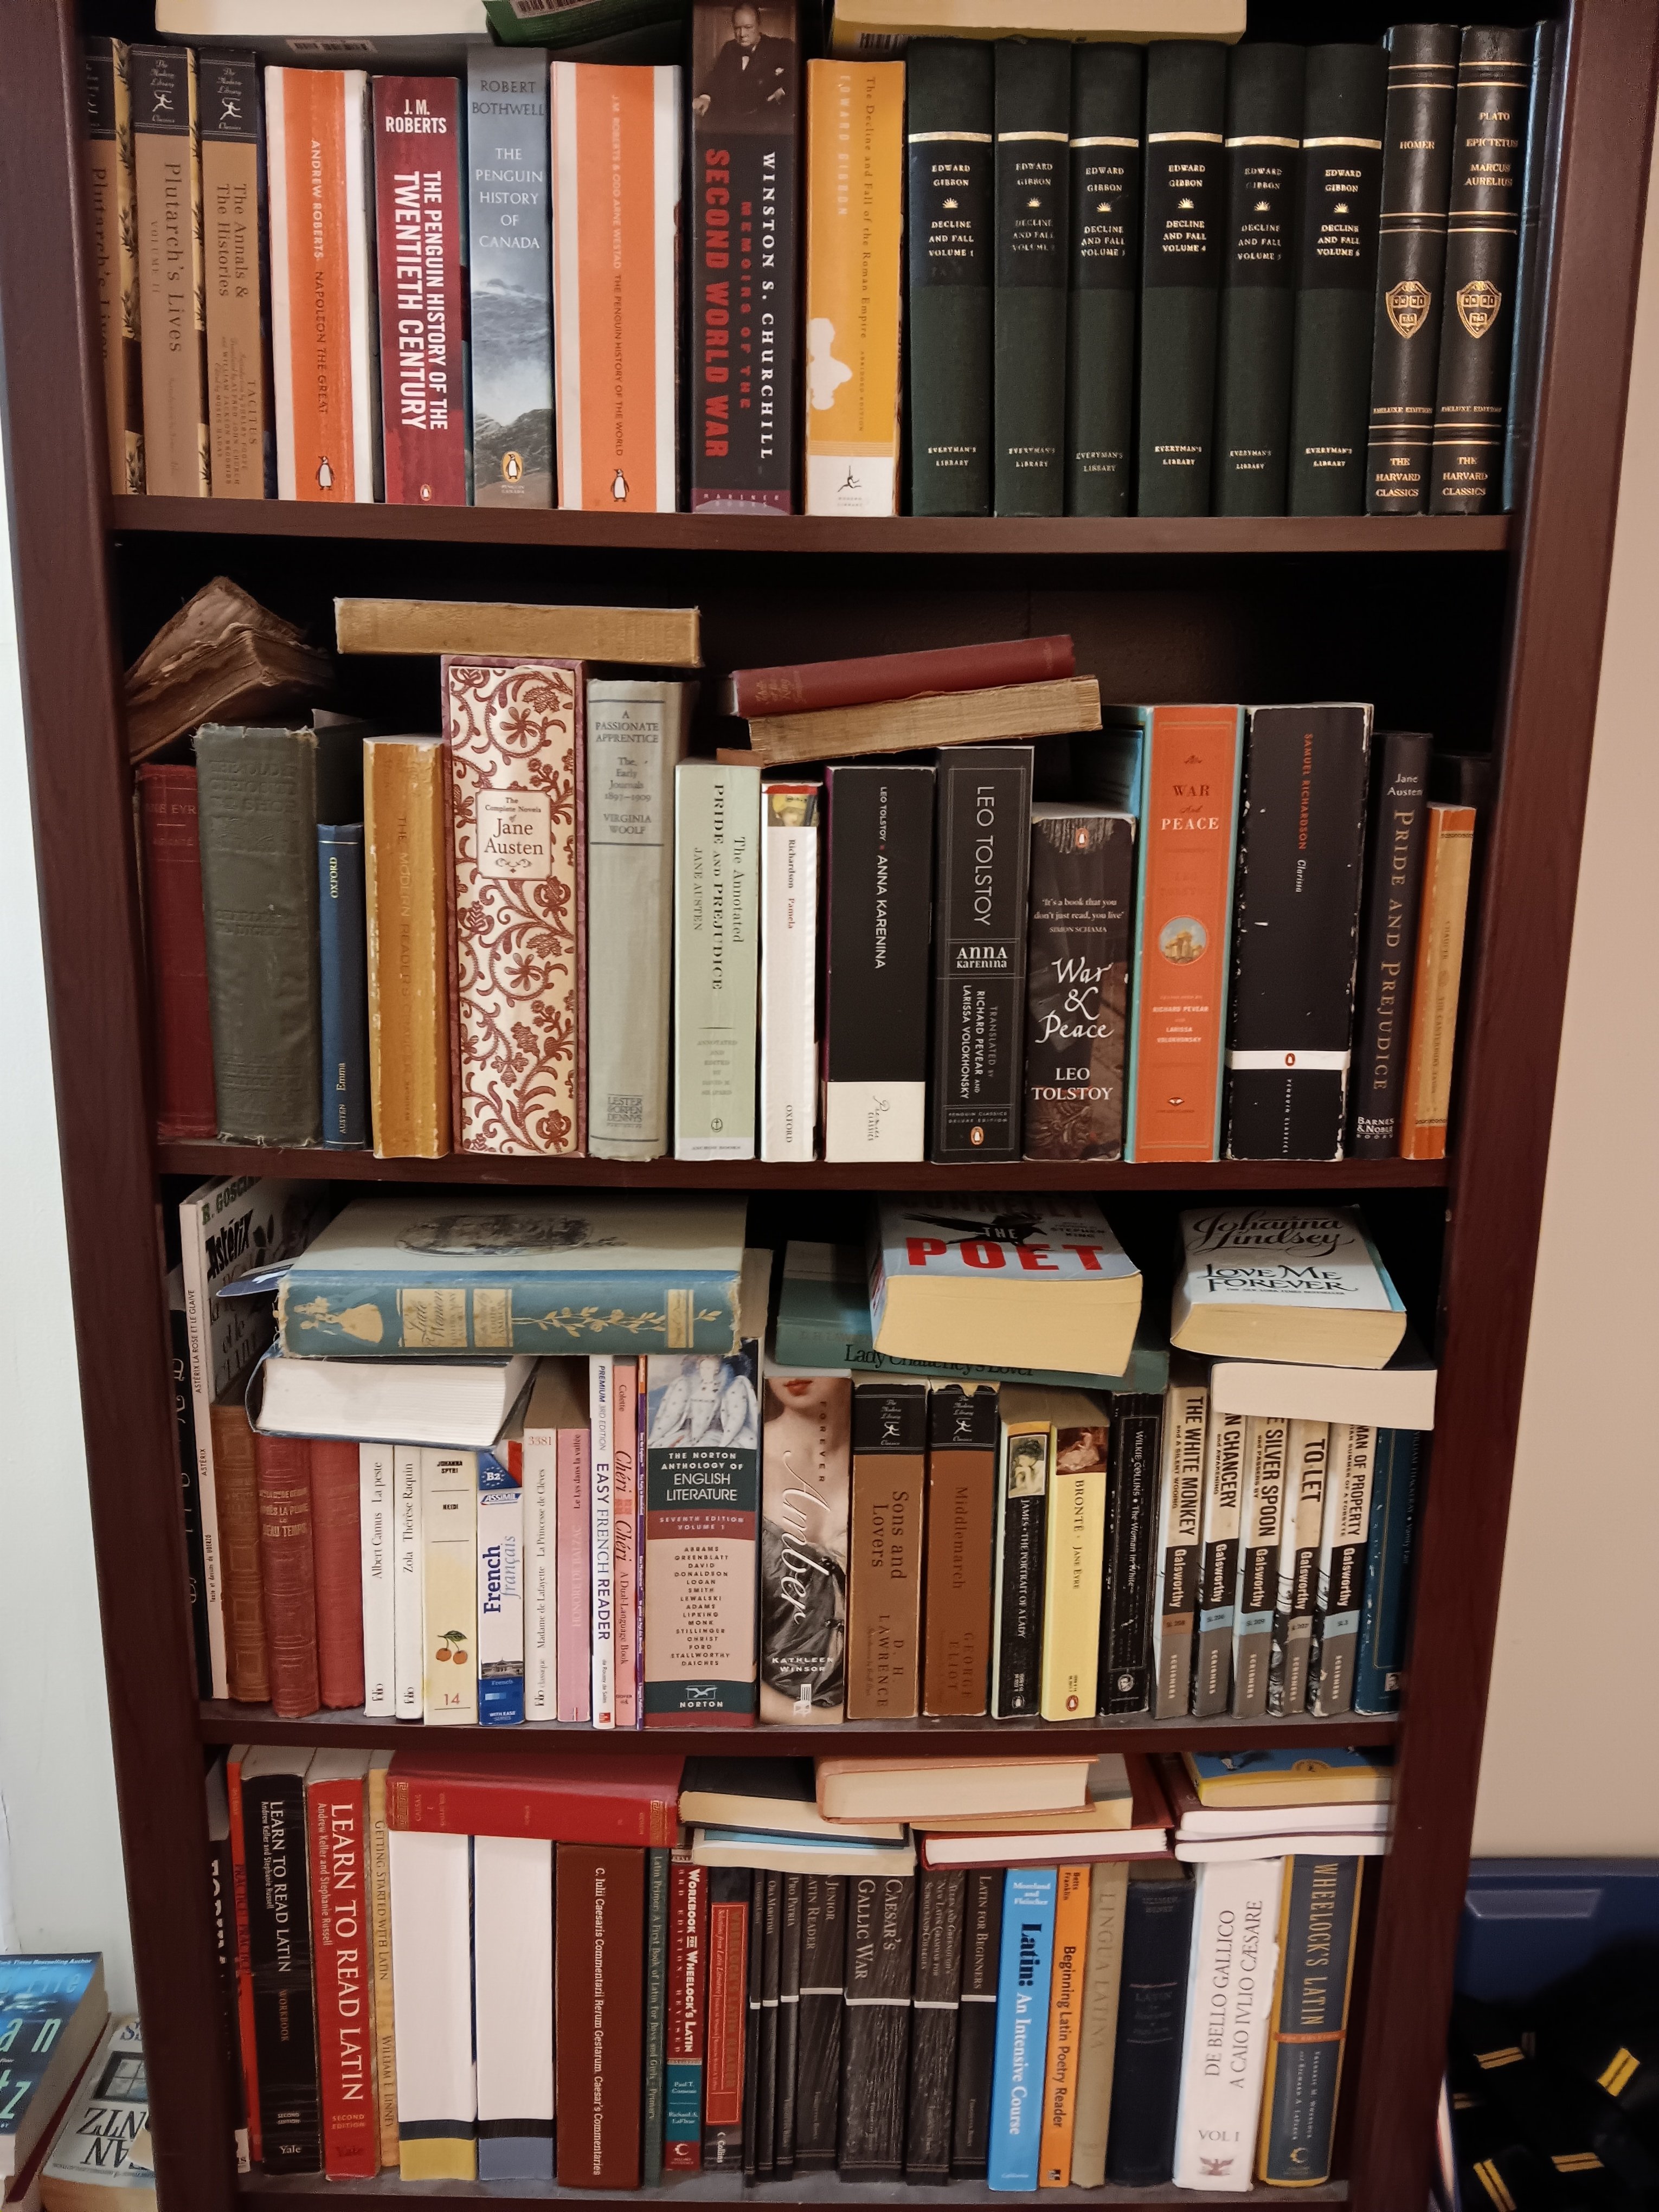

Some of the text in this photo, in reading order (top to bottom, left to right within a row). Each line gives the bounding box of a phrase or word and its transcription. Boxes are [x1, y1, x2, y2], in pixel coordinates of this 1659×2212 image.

[403, 99, 430, 116] J. M.
[471, 102, 545, 117] BOTHWELL
[480, 81, 536, 94] ROBERT
[385, 116, 447, 134] ROBERTS
[1479, 112, 1510, 121] PLATO
[494, 147, 523, 160] THE
[1399, 141, 1435, 150] HOMER
[475, 169, 543, 183] PENGUIN
[479, 192, 540, 205] HISTORY
[164, 163, 183, 281] Plutarch's
[217, 184, 232, 297] The Histories
[234, 183, 249, 298] The Annals &
[479, 236, 541, 249] CANADA
[499, 214, 520, 227] OF
[168, 293, 185, 353] Lives
[394, 170, 427, 430] TWENTIETH CENTURY
[423, 170, 448, 430] THE PENGUIN HISTORY OF THE
[705, 149, 730, 458] SECOND WORLD WAR
[760, 151, 776, 459] WINSTON S. CHURCHILL
[1375, 473, 1420, 482] HARVARD
[1375, 488, 1419, 497] CLASSICS
[595, 722, 660, 732] PASSIONATE
[595, 733, 660, 743] APPRENTICE
[1172, 785, 1211, 797] WAR
[1298, 732, 1313, 850] SAMUEL RICHARDSON
[1394, 774, 1419, 784] Jane
[485, 805, 515, 813] Complete
[493, 816, 534, 838] Jane
[603, 813, 652, 824] VIRGINIA
[1161, 817, 1220, 830] PEACE
[483, 840, 544, 856] Austen
[973, 786, 995, 926] LEO TOLSTOY
[693, 847, 703, 931] JANE AUSTEN
[711, 784, 725, 991] PRIDE AND PREJUDICE
[732, 836, 746, 943] The Annotated
[874, 786, 889, 969] LEO TOLSTOY ANNA KARENINA
[1295, 859, 1308, 893] Clarissa
[1051, 956, 1114, 984] War
[1373, 810, 1415, 1090] PRIDE AND PREJUDICE
[1064, 986, 1099, 1020] &
[959, 984, 973, 1100] LARISSA VOLOKHONSKY
[1034, 1010, 1116, 1044] Peace
[1031, 1086, 1114, 1101] TOLSTOY
[1054, 1068, 1091, 1081] LEO
[1357, 1116, 1395, 1126] BARNES
[905, 1237, 1104, 1271] POET
[1207, 1277, 1359, 1293] FOREVER
[618, 1384, 627, 1412] Colette
[668, 1451, 736, 1460] THE NORTON
[819, 1400, 827, 1483] FOREVER
[486, 1471, 501, 1481] B2
[614, 1450, 633, 1493] Chéri
[661, 1462, 724, 1471] ANTHOLOGY
[673, 1472, 731, 1486] ENGLISH
[1178, 1396, 1204, 1536] THE WHITE MONKEY
[1219, 1430, 1241, 1509] CHANCERY
[1258, 1429, 1284, 1538] SILVER SPOON
[1300, 1438, 1326, 1503] TO LET
[666, 1488, 738, 1502] LITERATURE
[1347, 1454, 1367, 1535] OF PROPERTY
[371, 1462, 385, 1579] Albert Camus La peste
[402, 1463, 416, 1573] Zola Thérèse Raquin
[614, 1519, 633, 1562] Chéri
[871, 1503, 890, 1568] Lovers
[890, 1490, 910, 1580] Sons and
[951, 1487, 969, 1589] Middlemarch
[596, 1463, 611, 1640] EASY FRENCH READER
[1210, 1543, 1228, 1603] Galsworthy
[482, 1545, 501, 1614] French
[1169, 1548, 1187, 1607] Galsworthy
[1250, 1548, 1269, 1607] Galsworthy
[618, 1579, 629, 1642] Dual-Language
[620, 1644, 629, 1666] Book
[779, 1665, 826, 1673] WINSOR
[443, 1693, 460, 1705] 14
[269, 1801, 292, 1973] LEARN TO READ LATIN
[825, 1881, 840, 1920] JUNIOR
[806, 1907, 821, 1950] READER
[854, 1879, 876, 1979] GALLIC WAR
[883, 1879, 904, 1951] CAESAR'S
[973, 1876, 993, 1989] LATIN FOR BEGINNERS
[1304, 1863, 1339, 1967] WHEELOCK'S
[330, 1803, 364, 2100] LEARN TO READ LATIN
[684, 1868, 700, 2053] WORKBOOK FOR WHEELOCK'S LATIN
[1204, 1909, 1236, 2077] DE BELLO GALLICO
[1229, 1900, 1263, 2089] A CAIO IVLIO CÆSARE
[1300, 1976, 1328, 2025] LATIN
[1009, 1922, 1043, 2135] Latin: An Intensive Course
[1052, 1945, 1077, 2128] Beginning Latin Poetry Reader
[279, 2145, 302, 2155] Yale
